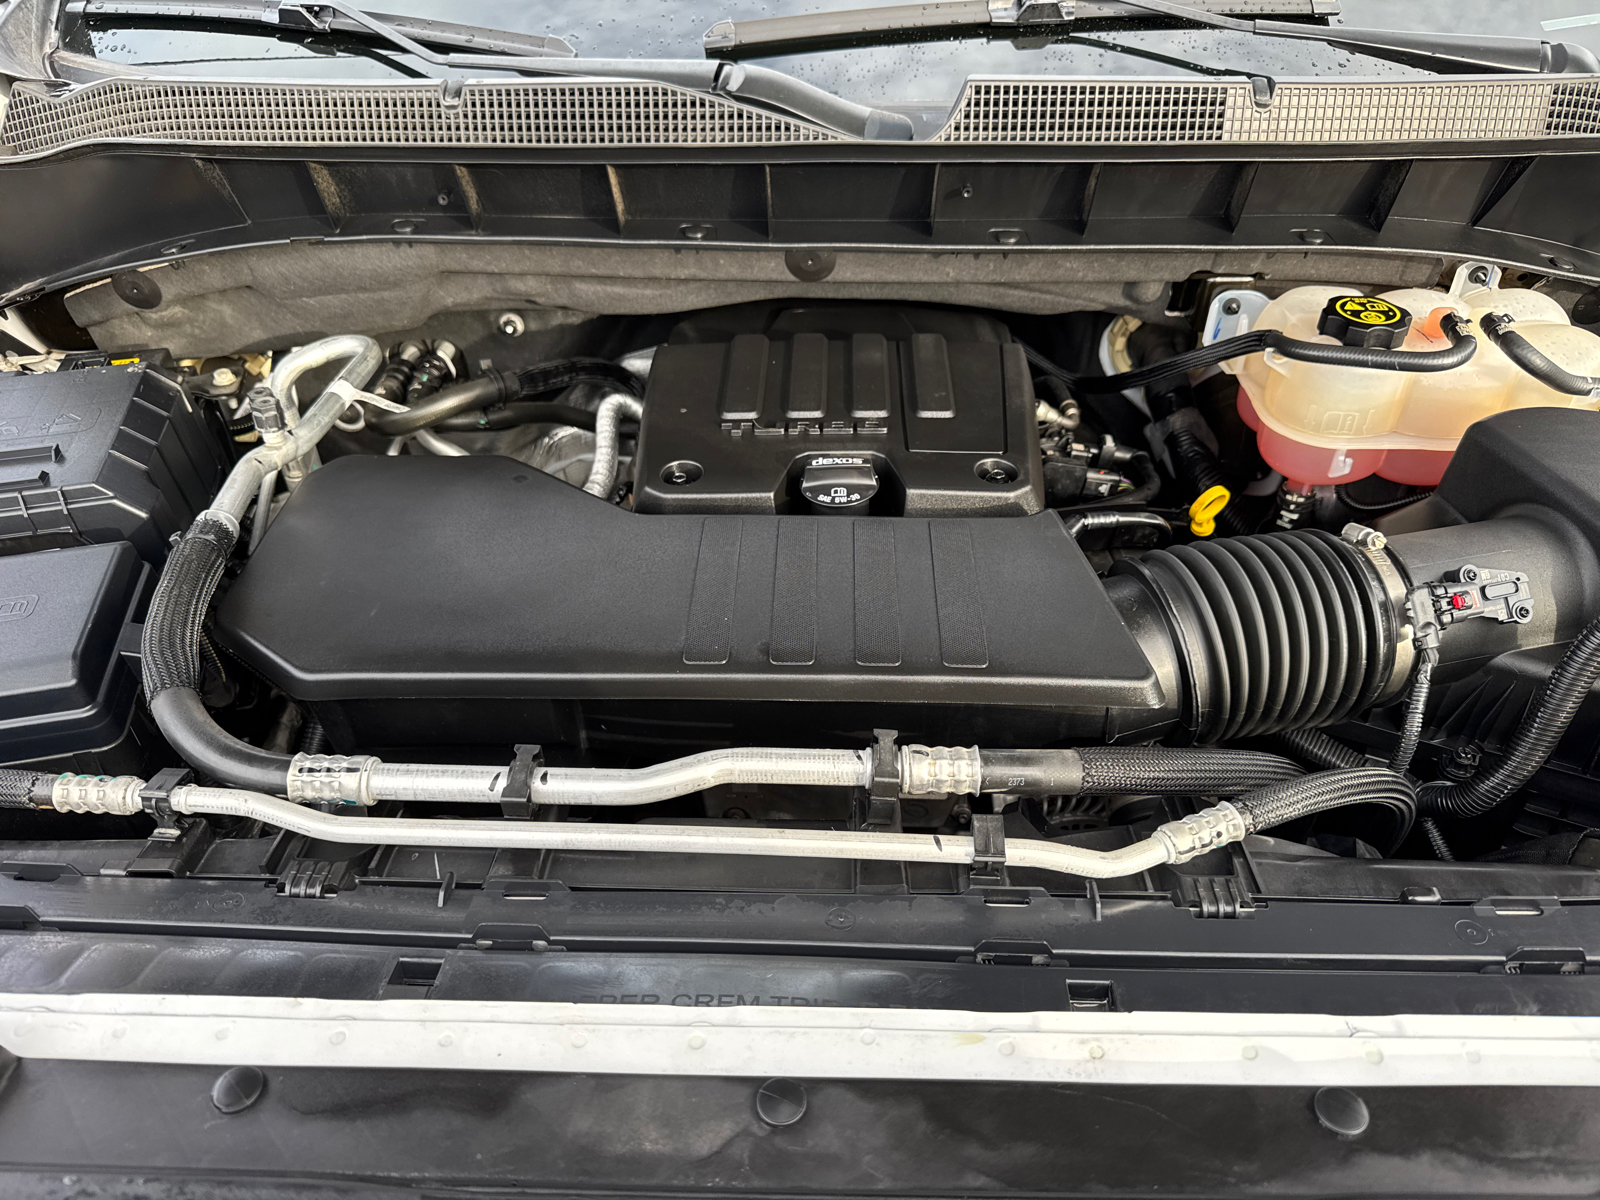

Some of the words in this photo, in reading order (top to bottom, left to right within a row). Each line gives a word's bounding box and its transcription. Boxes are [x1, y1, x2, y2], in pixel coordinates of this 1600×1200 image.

[812, 457, 864, 466] dexos
[817, 494, 832, 502] SAE
[1008, 777, 1025, 786] 2373
